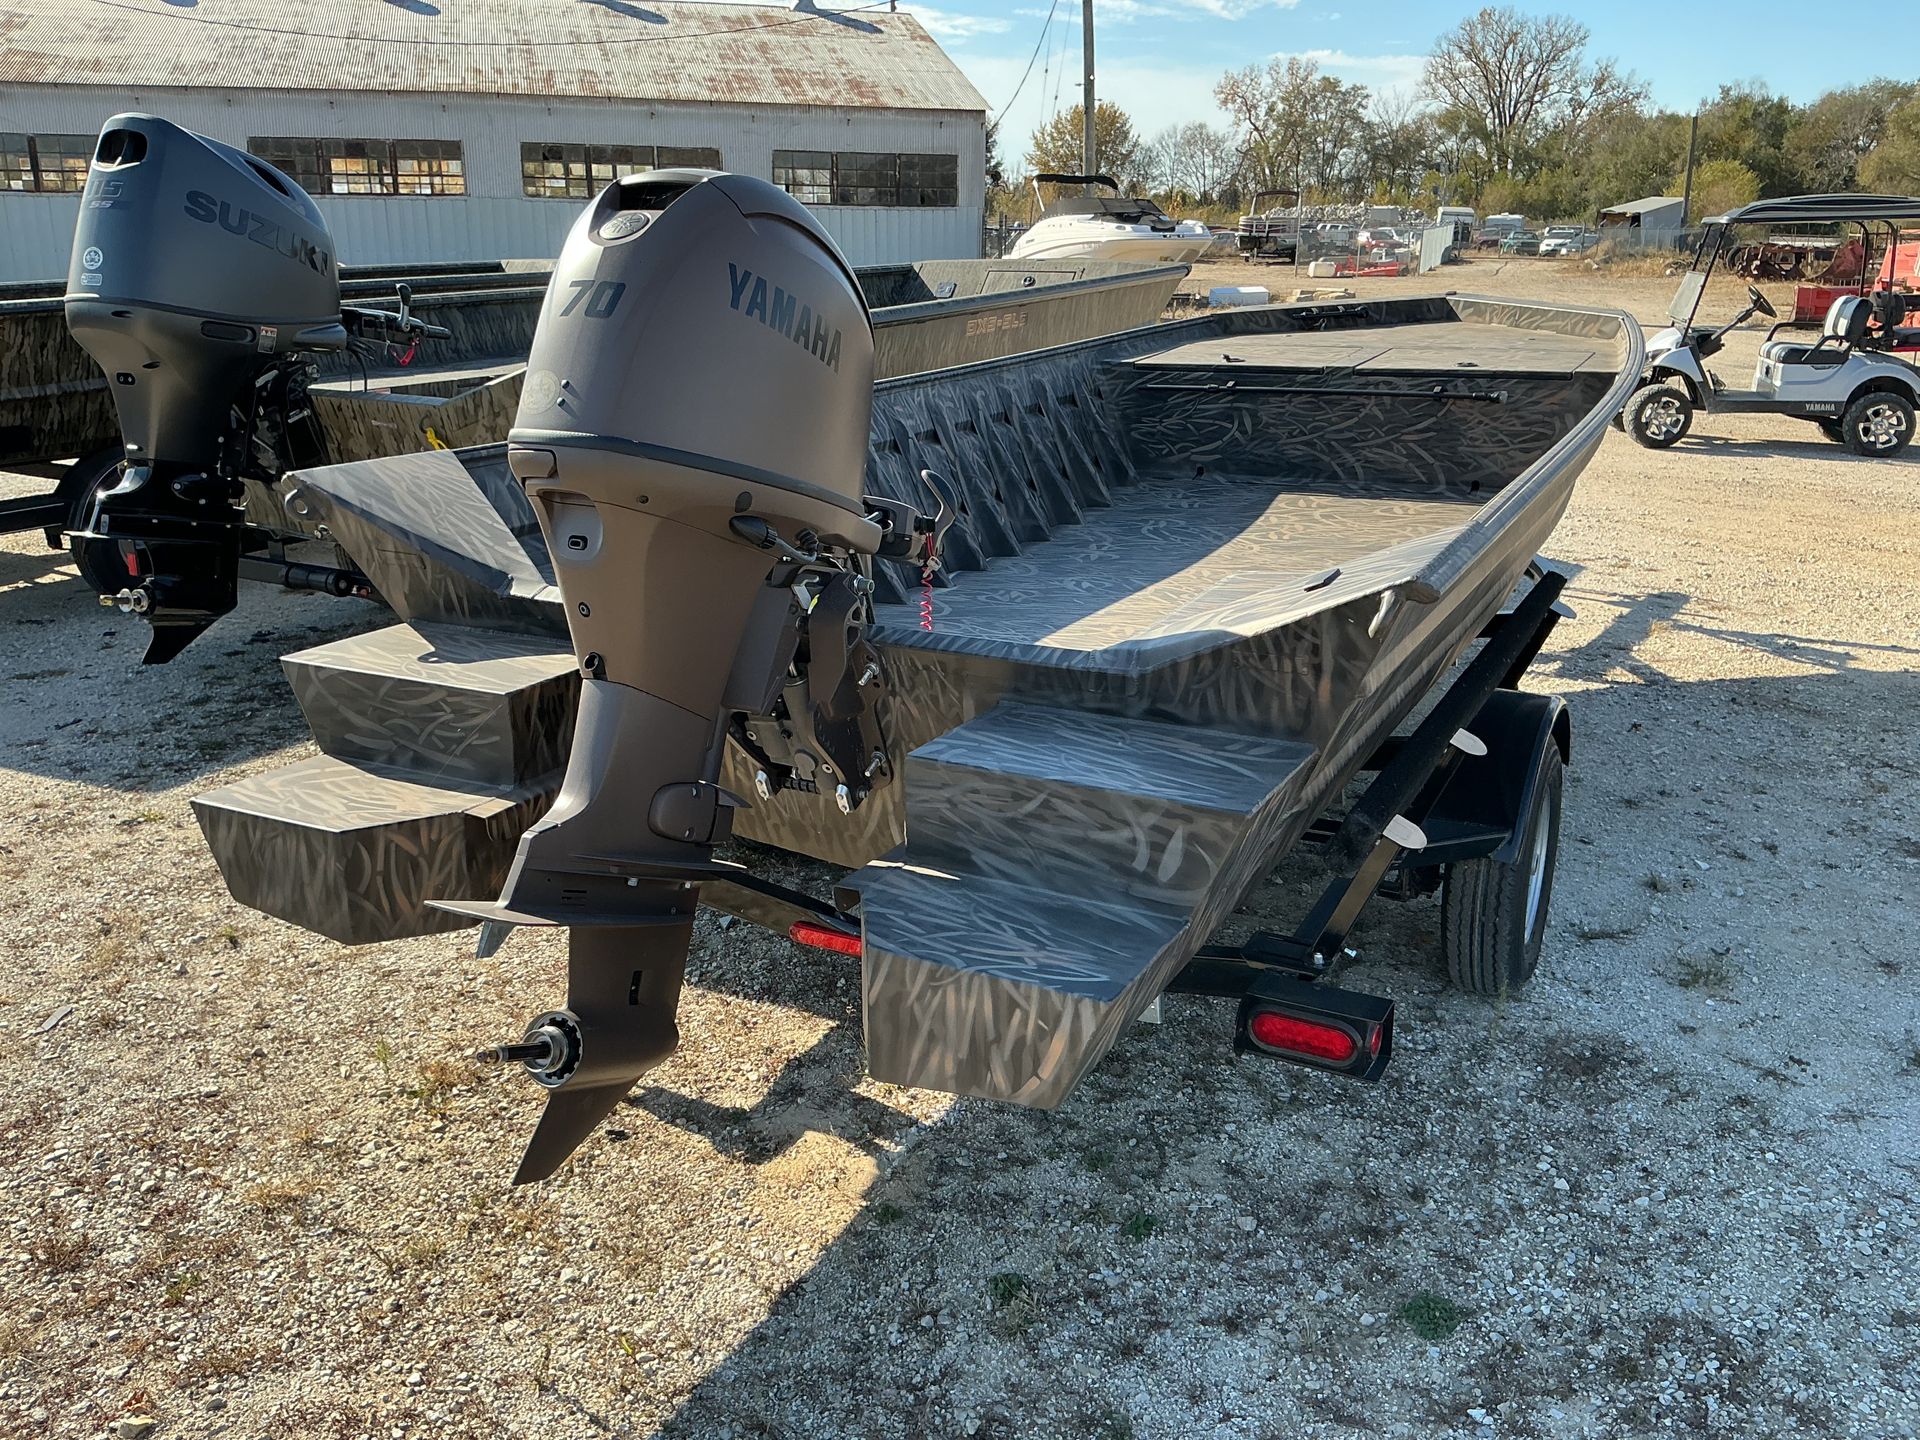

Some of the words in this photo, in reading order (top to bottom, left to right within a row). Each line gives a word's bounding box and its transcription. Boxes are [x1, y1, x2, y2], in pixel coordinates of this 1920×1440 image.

[183, 190, 328, 277] SUZUKI
[559, 279, 626, 318] 70
[728, 261, 842, 374] YAMAHA
[1805, 403, 1836, 411] YAMAHA
